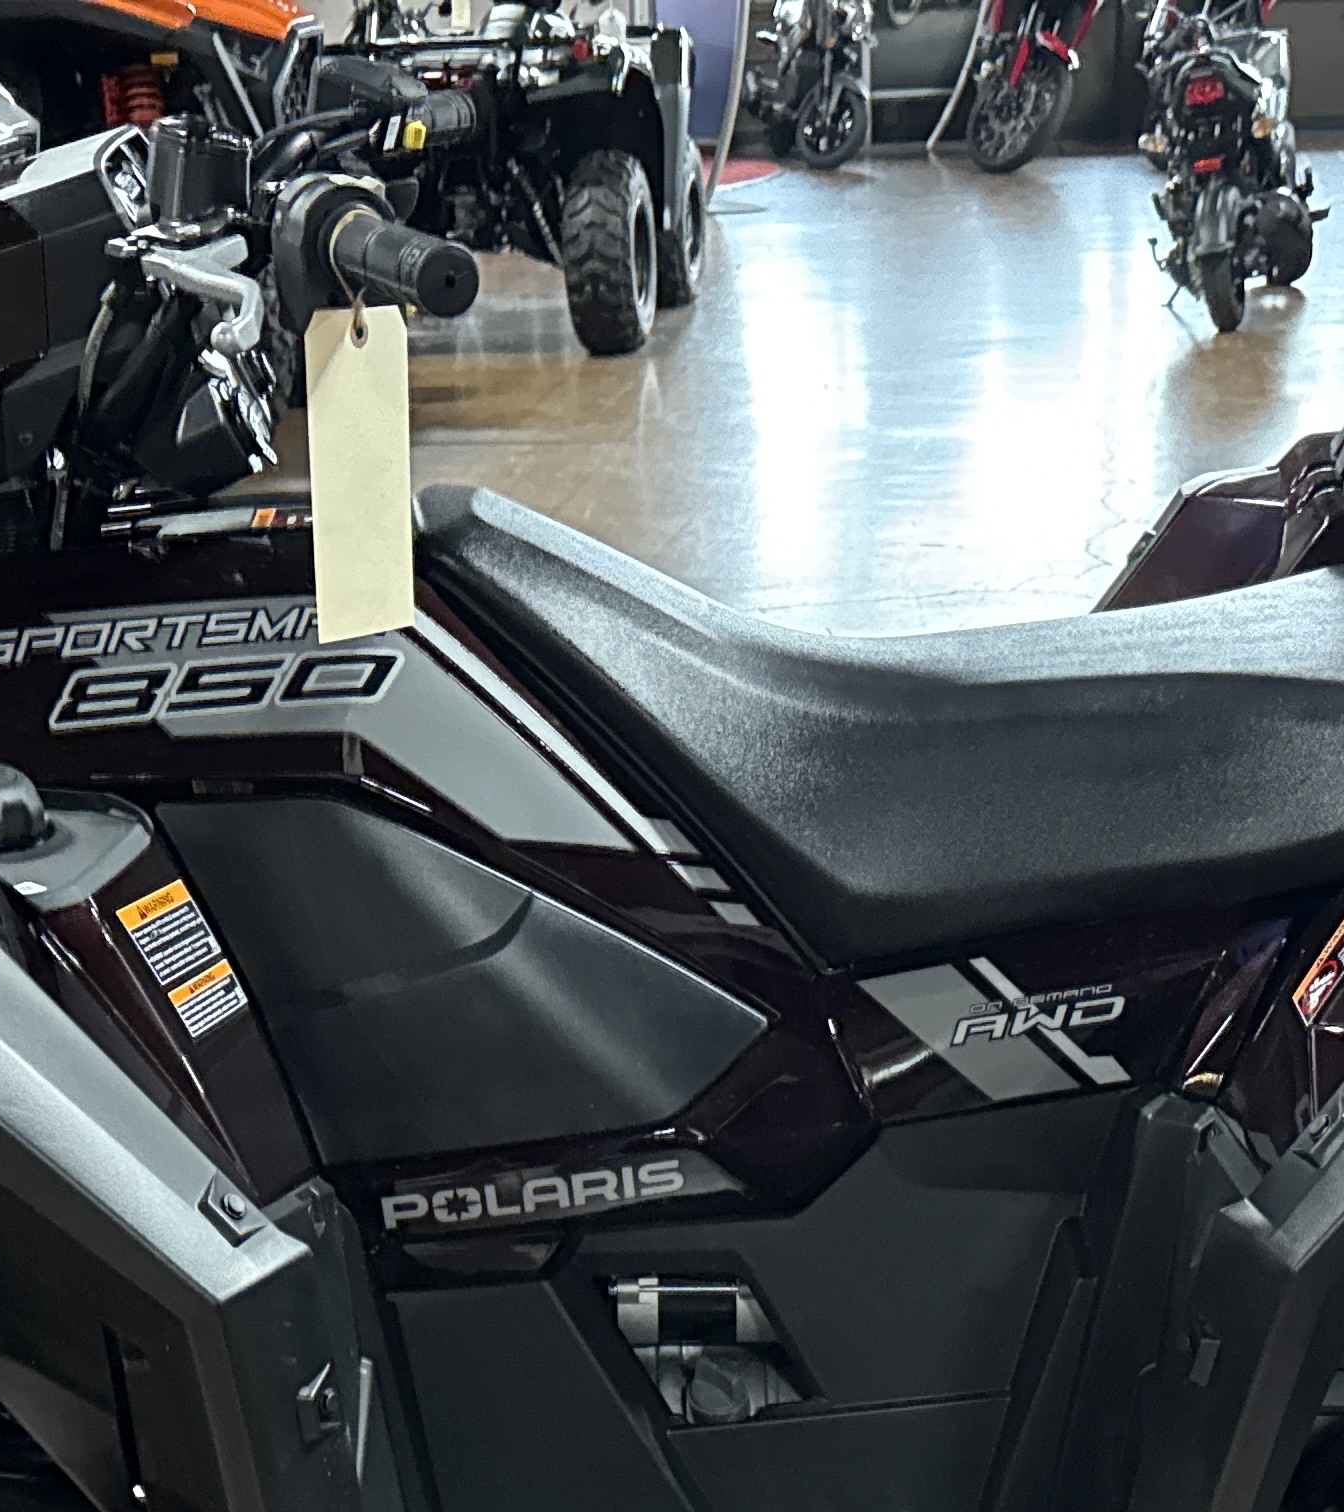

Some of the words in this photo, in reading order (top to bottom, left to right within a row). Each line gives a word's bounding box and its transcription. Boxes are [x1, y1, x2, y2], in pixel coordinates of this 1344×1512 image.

[49, 648, 405, 733] 850
[950, 995, 1126, 1048] AWD
[380, 1159, 685, 1230] POLARIS
